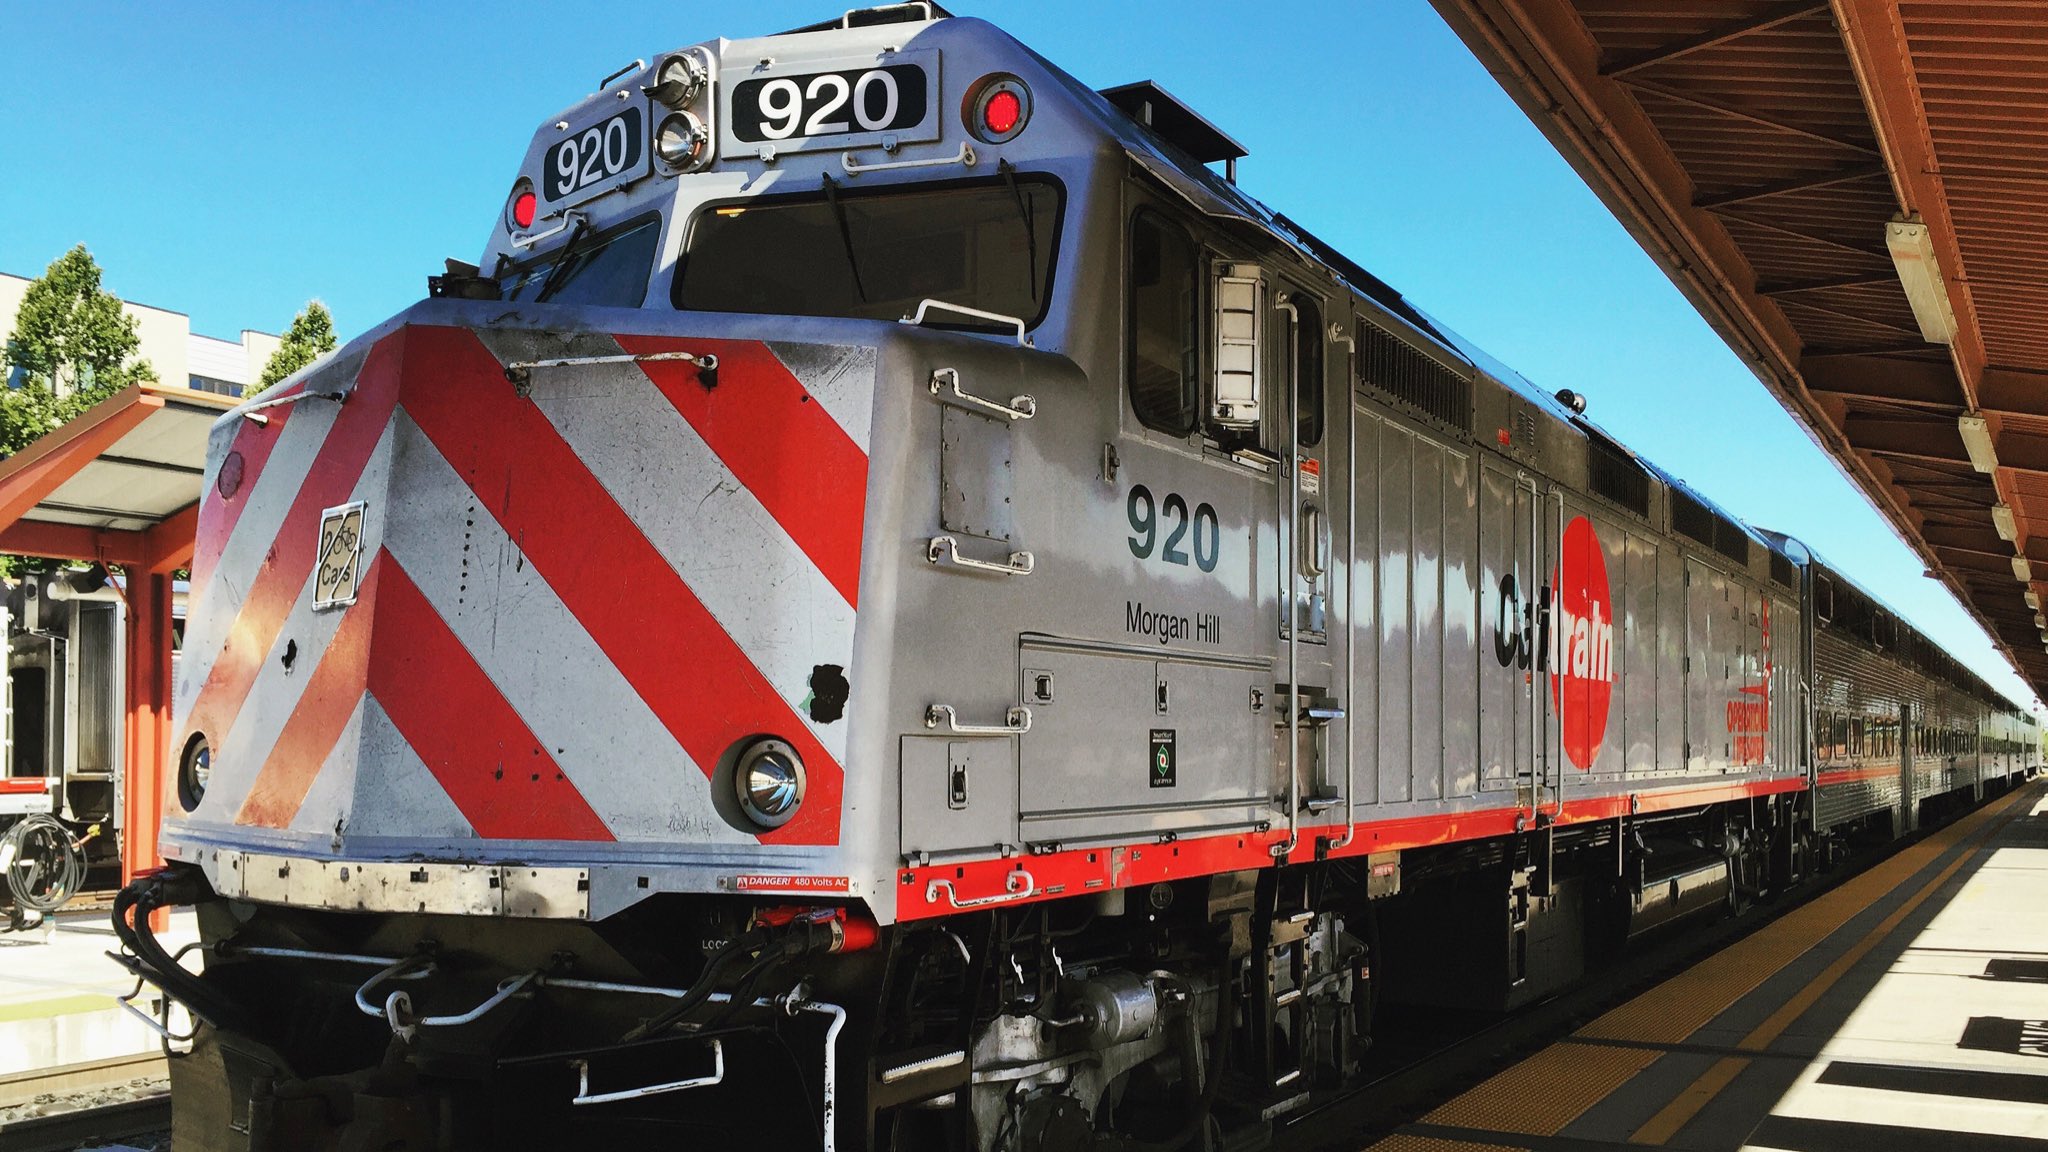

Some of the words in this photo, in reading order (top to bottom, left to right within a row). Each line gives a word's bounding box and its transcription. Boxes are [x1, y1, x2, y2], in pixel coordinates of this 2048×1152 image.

[758, 69, 899, 140] 920
[557, 116, 628, 195] 920
[1126, 483, 1220, 573] 920
[1126, 600, 1189, 645] Morgan
[1196, 612, 1220, 645] Hill
[748, 877, 791, 886] DANGER!
[794, 878, 810, 887] 480
[811, 878, 833, 887] Volts
[834, 879, 847, 887] AC
